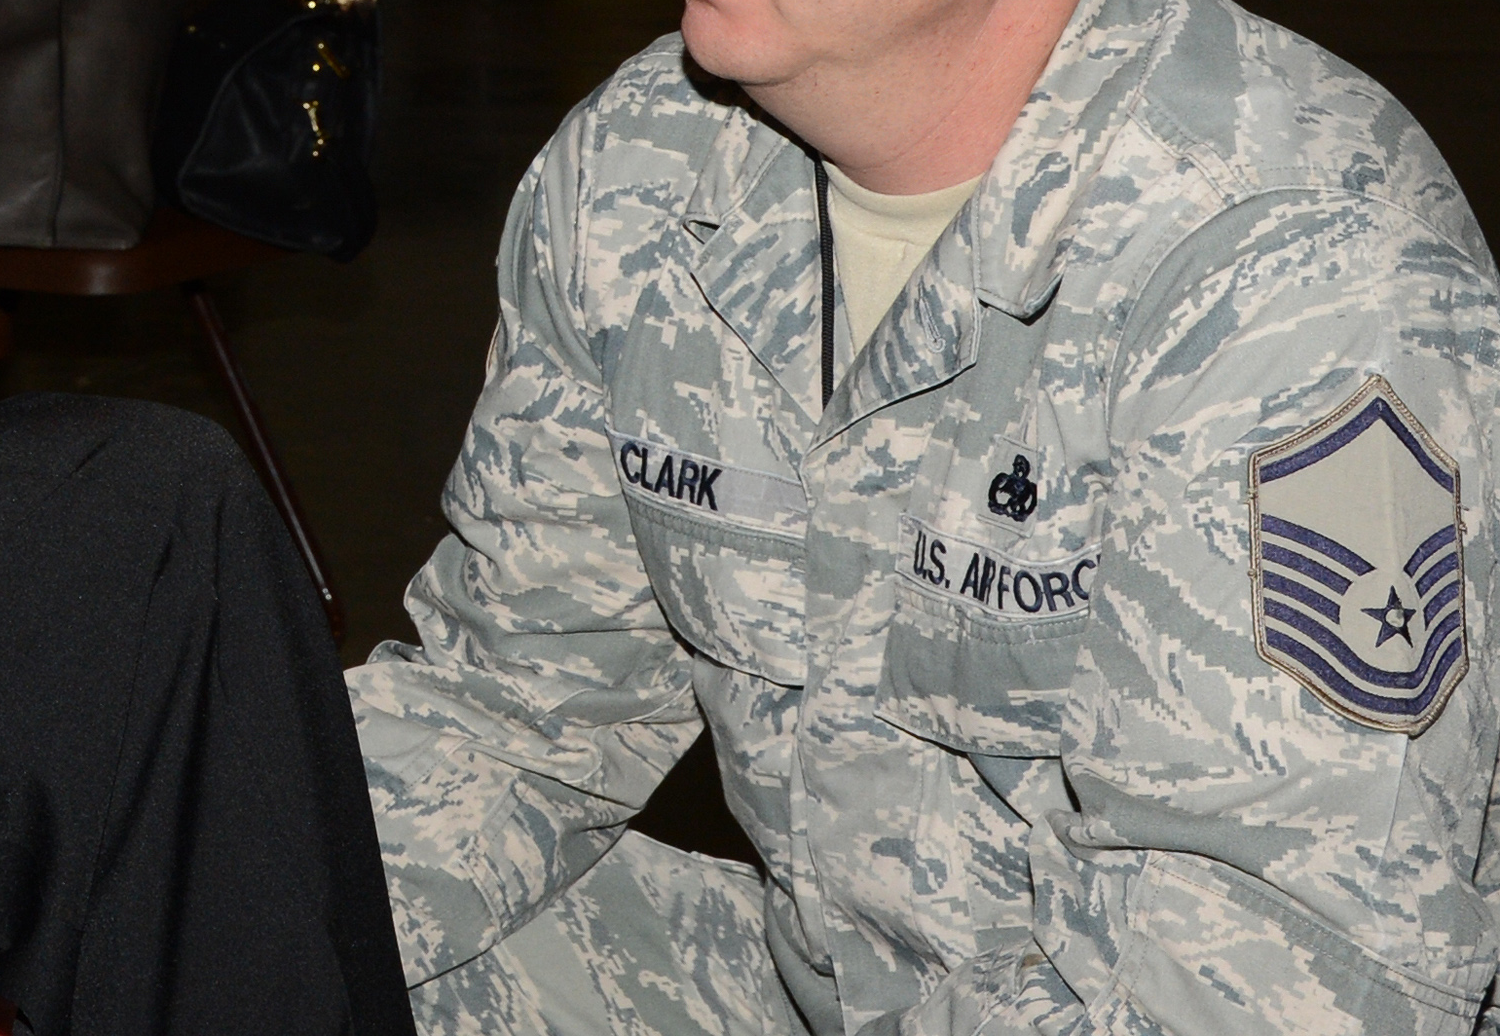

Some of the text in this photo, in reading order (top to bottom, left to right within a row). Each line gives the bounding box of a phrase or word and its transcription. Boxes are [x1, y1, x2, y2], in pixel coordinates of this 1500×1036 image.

[620, 440, 722, 511] CLARK
[913, 530, 950, 589] U.S.
[998, 554, 1101, 613] FORC
